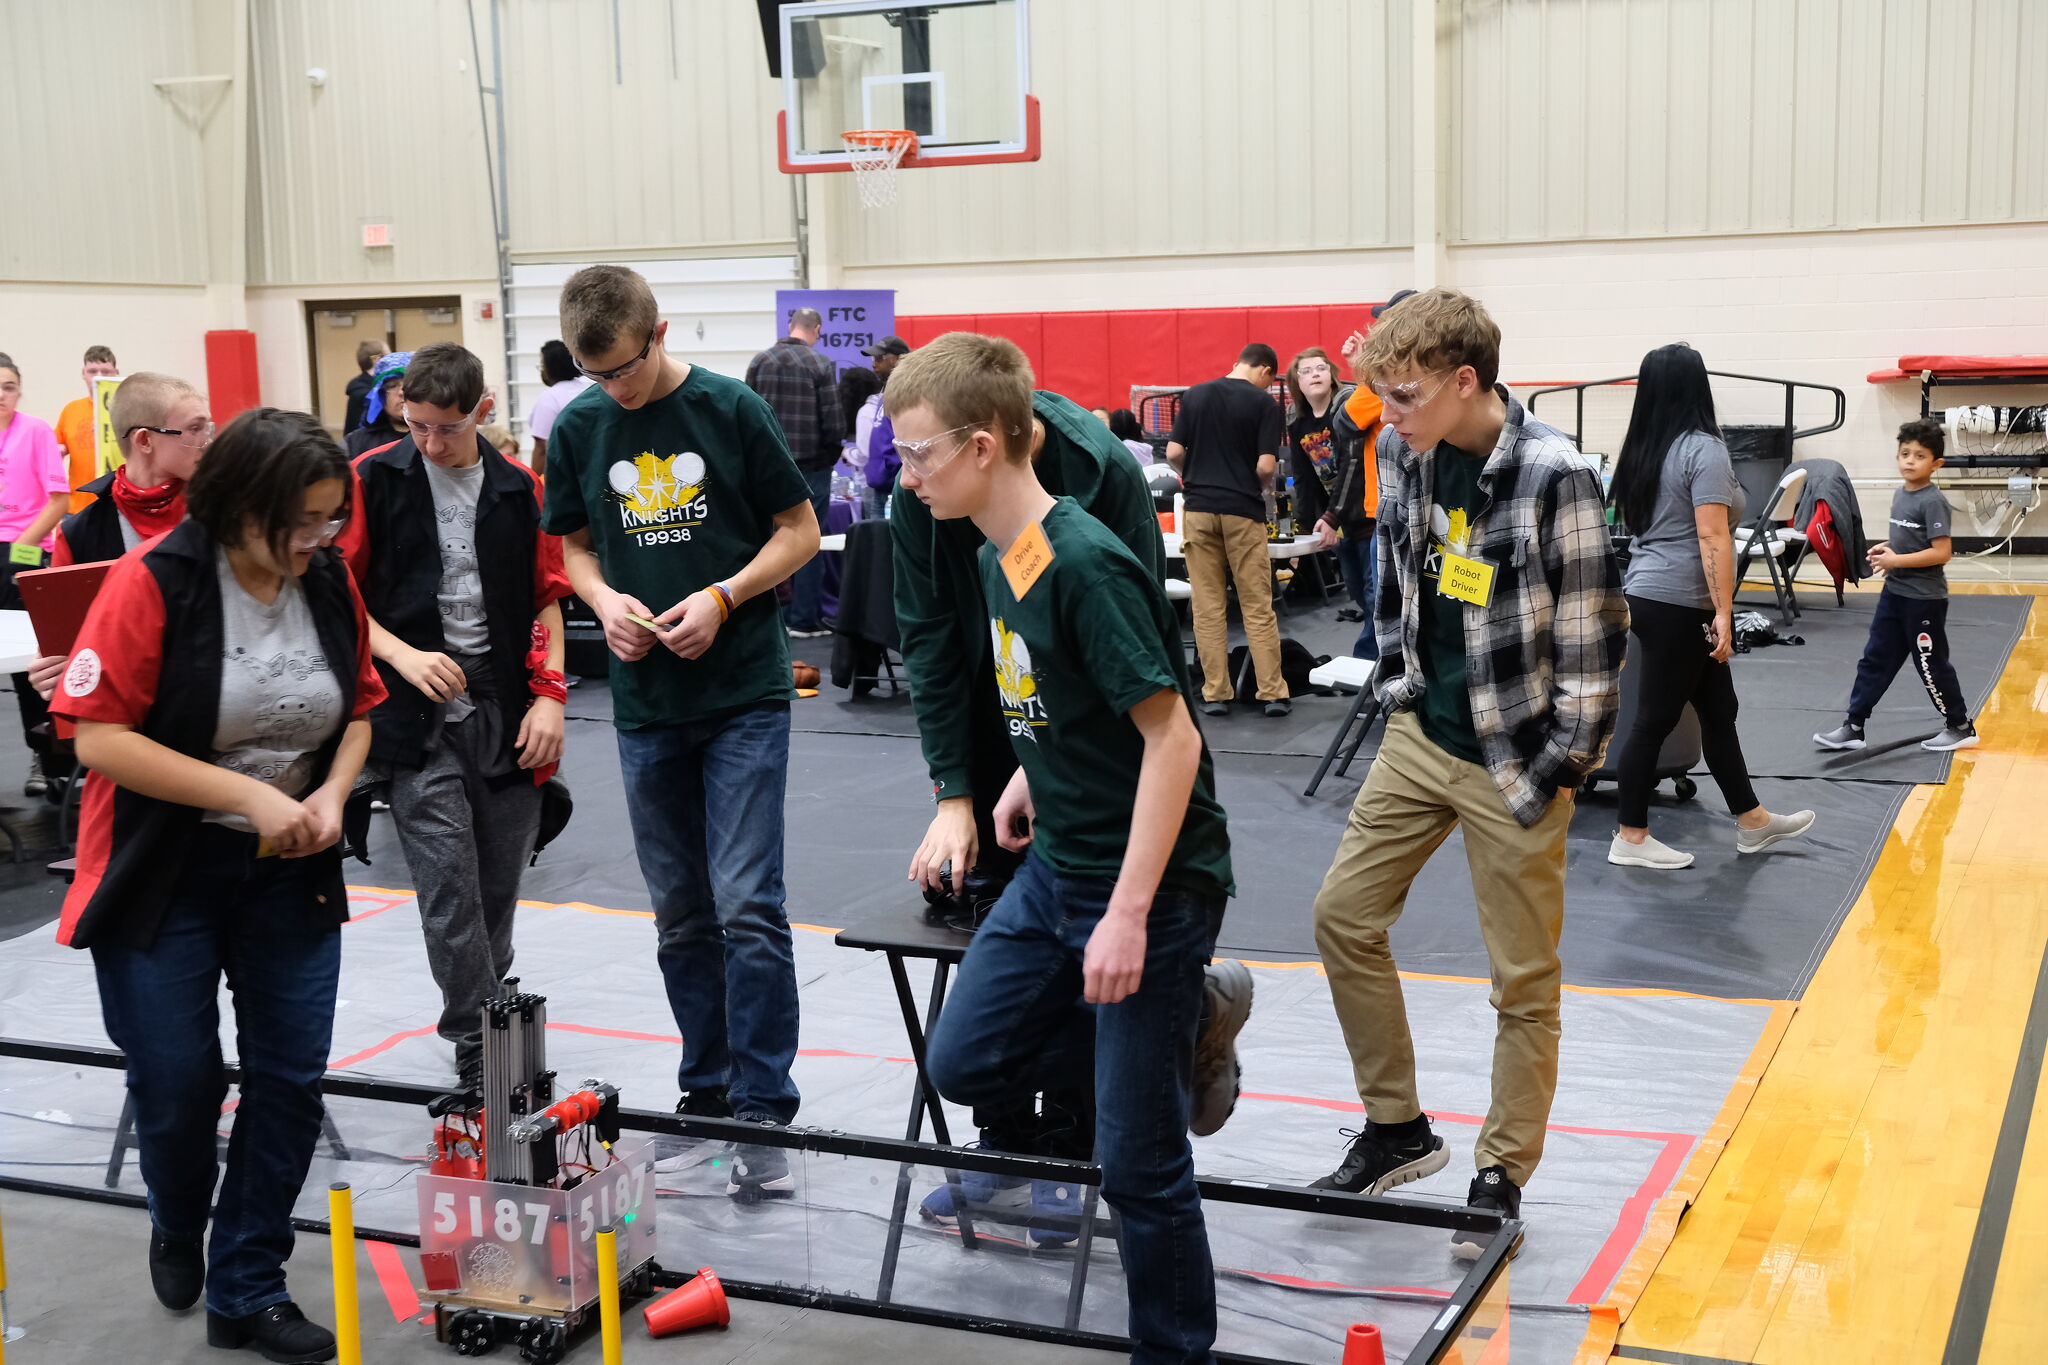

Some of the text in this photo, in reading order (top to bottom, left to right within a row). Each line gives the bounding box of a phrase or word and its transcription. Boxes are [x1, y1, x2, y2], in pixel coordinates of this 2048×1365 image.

[828, 307, 866, 322] FTC
[819, 333, 873, 348] 16751
[619, 494, 708, 528] KNIGHTS
[636, 528, 691, 547] 19938
[1014, 540, 1033, 565] Drive
[1021, 554, 1042, 580] Coach
[1454, 565, 1480, 581] Robot
[1451, 579, 1478, 595] Driver
[580, 1162, 647, 1243] 5187
[434, 1191, 551, 1245] 5187
